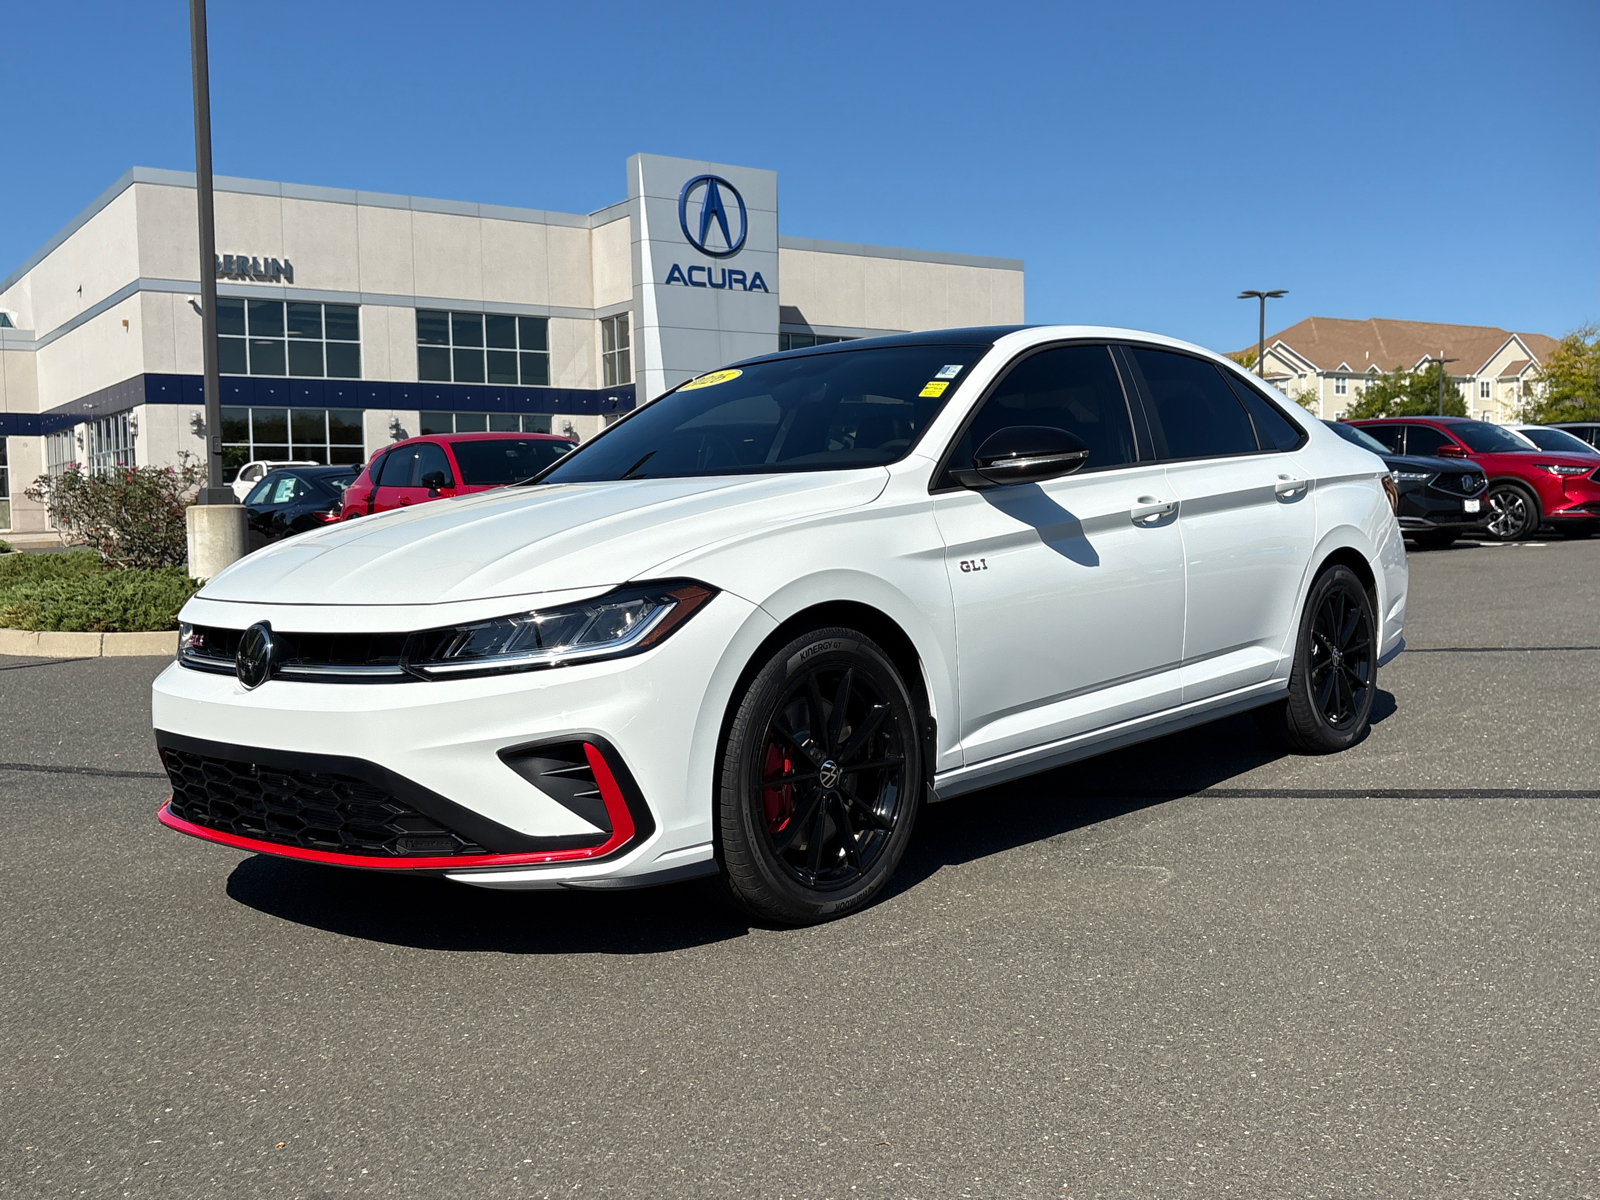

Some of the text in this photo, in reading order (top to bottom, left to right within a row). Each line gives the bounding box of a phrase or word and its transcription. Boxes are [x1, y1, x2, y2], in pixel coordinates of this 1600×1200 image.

[665, 263, 770, 293] ACURA
[960, 558, 988, 573] GLI
[799, 641, 842, 661] KINERGY GT
